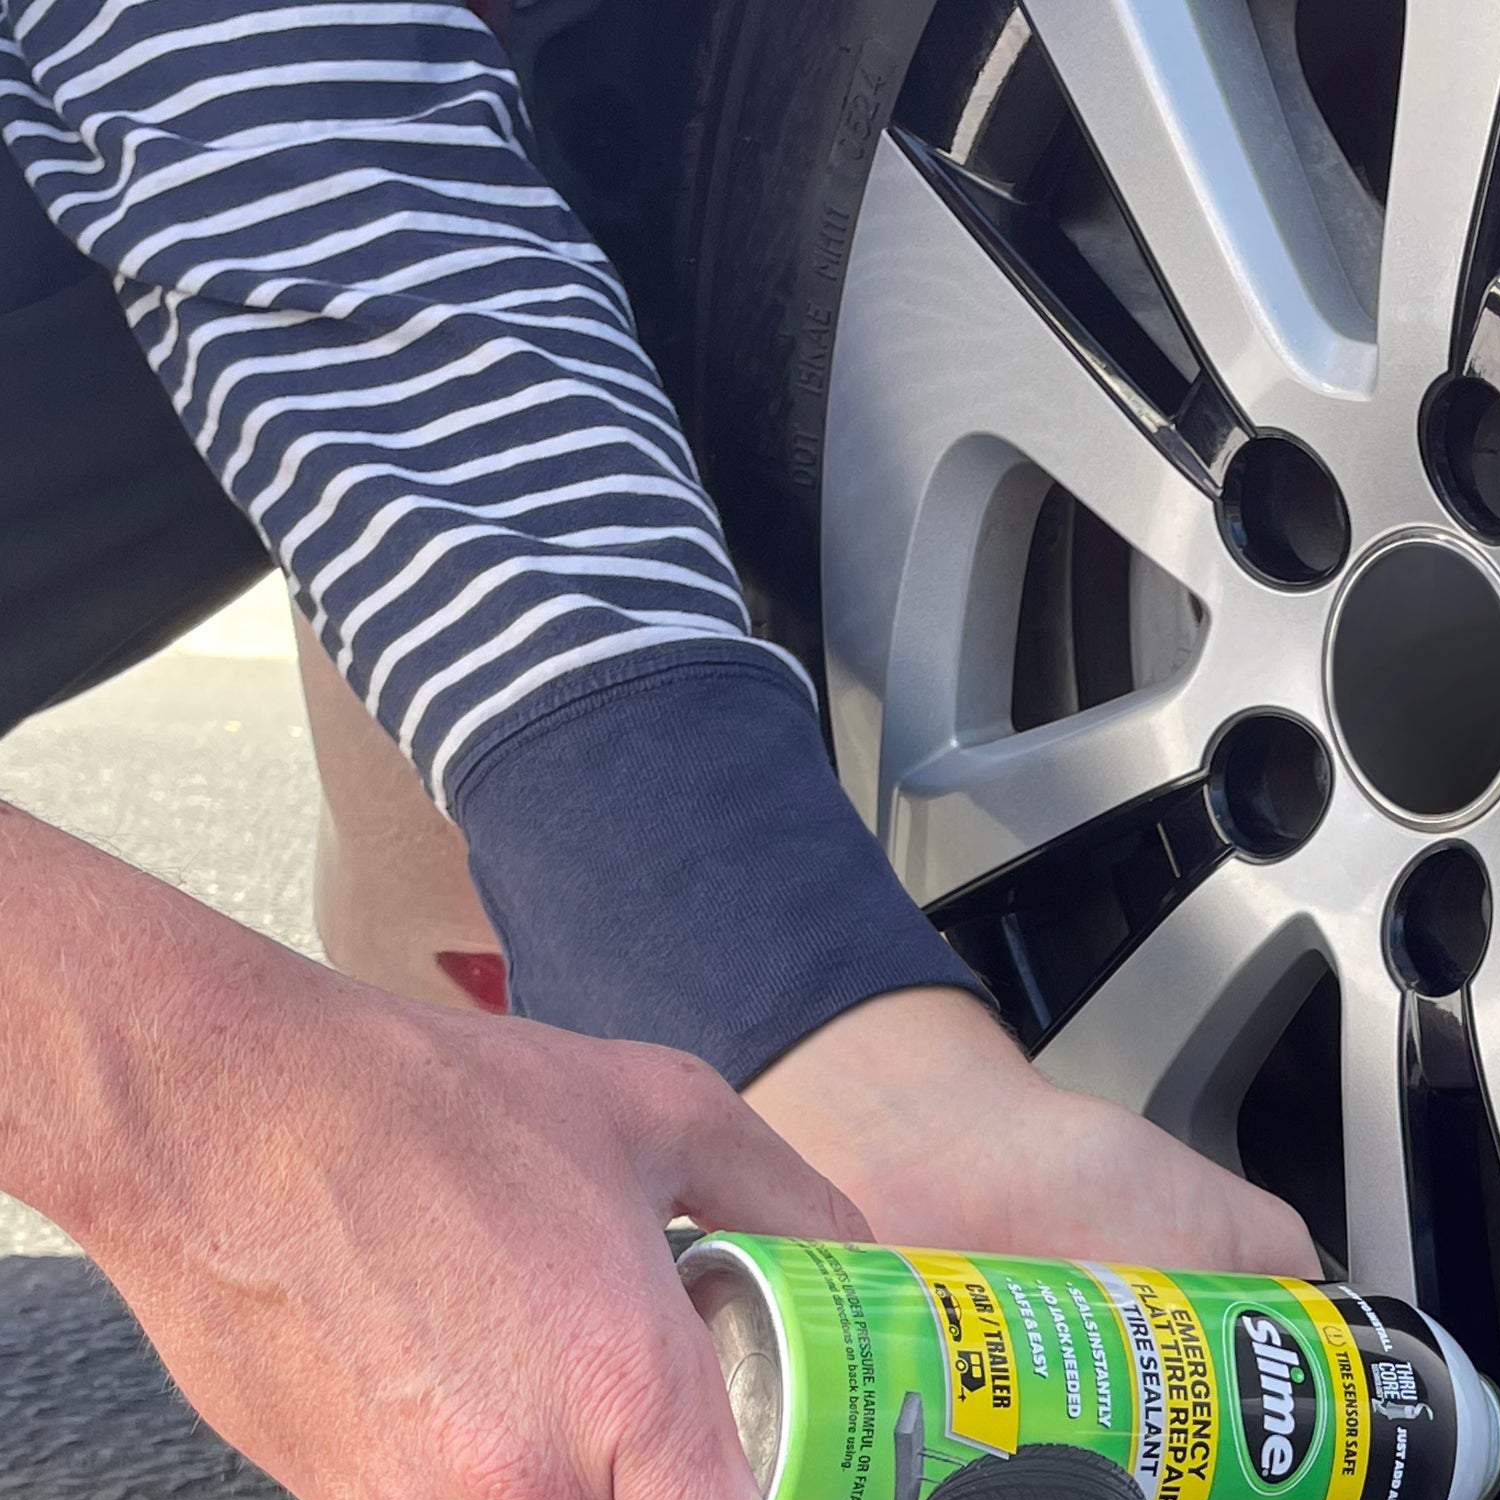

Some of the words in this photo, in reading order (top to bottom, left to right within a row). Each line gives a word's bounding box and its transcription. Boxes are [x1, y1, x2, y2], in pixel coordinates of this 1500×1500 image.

[790, 424, 819, 490] DOT
[832, 1294, 853, 1345] directions
[843, 1284, 864, 1318] UNDER
[965, 1283, 995, 1314] CAR
[984, 1330, 1011, 1409] TRAILER
[1007, 1282, 1035, 1319] SAFE
[1027, 1331, 1049, 1379] EASY
[1038, 1284, 1057, 1306] NO
[1049, 1306, 1073, 1346] JACK
[1061, 1346, 1081, 1420] NEEDED
[1131, 1283, 1176, 1336] FLAT
[1161, 1336, 1188, 1401] TIRE
[845, 1347, 856, 1360] on
[1068, 1287, 1098, 1332] SEALS
[1087, 1332, 1112, 1429] INSTANTLY
[1336, 1351, 1354, 1380] TIRE
[848, 1364, 859, 1393] back
[1122, 1302, 1154, 1351] TIRE
[1139, 1354, 1163, 1477] SEALANT
[1170, 1309, 1211, 1481] EMERGENCY
[1378, 1362, 1401, 1400] CORE
[1395, 1362, 1418, 1400] THRU
[847, 1395, 860, 1433] before
[860, 1390, 876, 1451] HARMFUL
[1342, 1383, 1359, 1436] SENSOR
[856, 1455, 871, 1472] OR
[1342, 1439, 1358, 1476] SAFE
[1396, 1426, 1408, 1459] JUST
[1391, 1460, 1405, 1489] ADD
